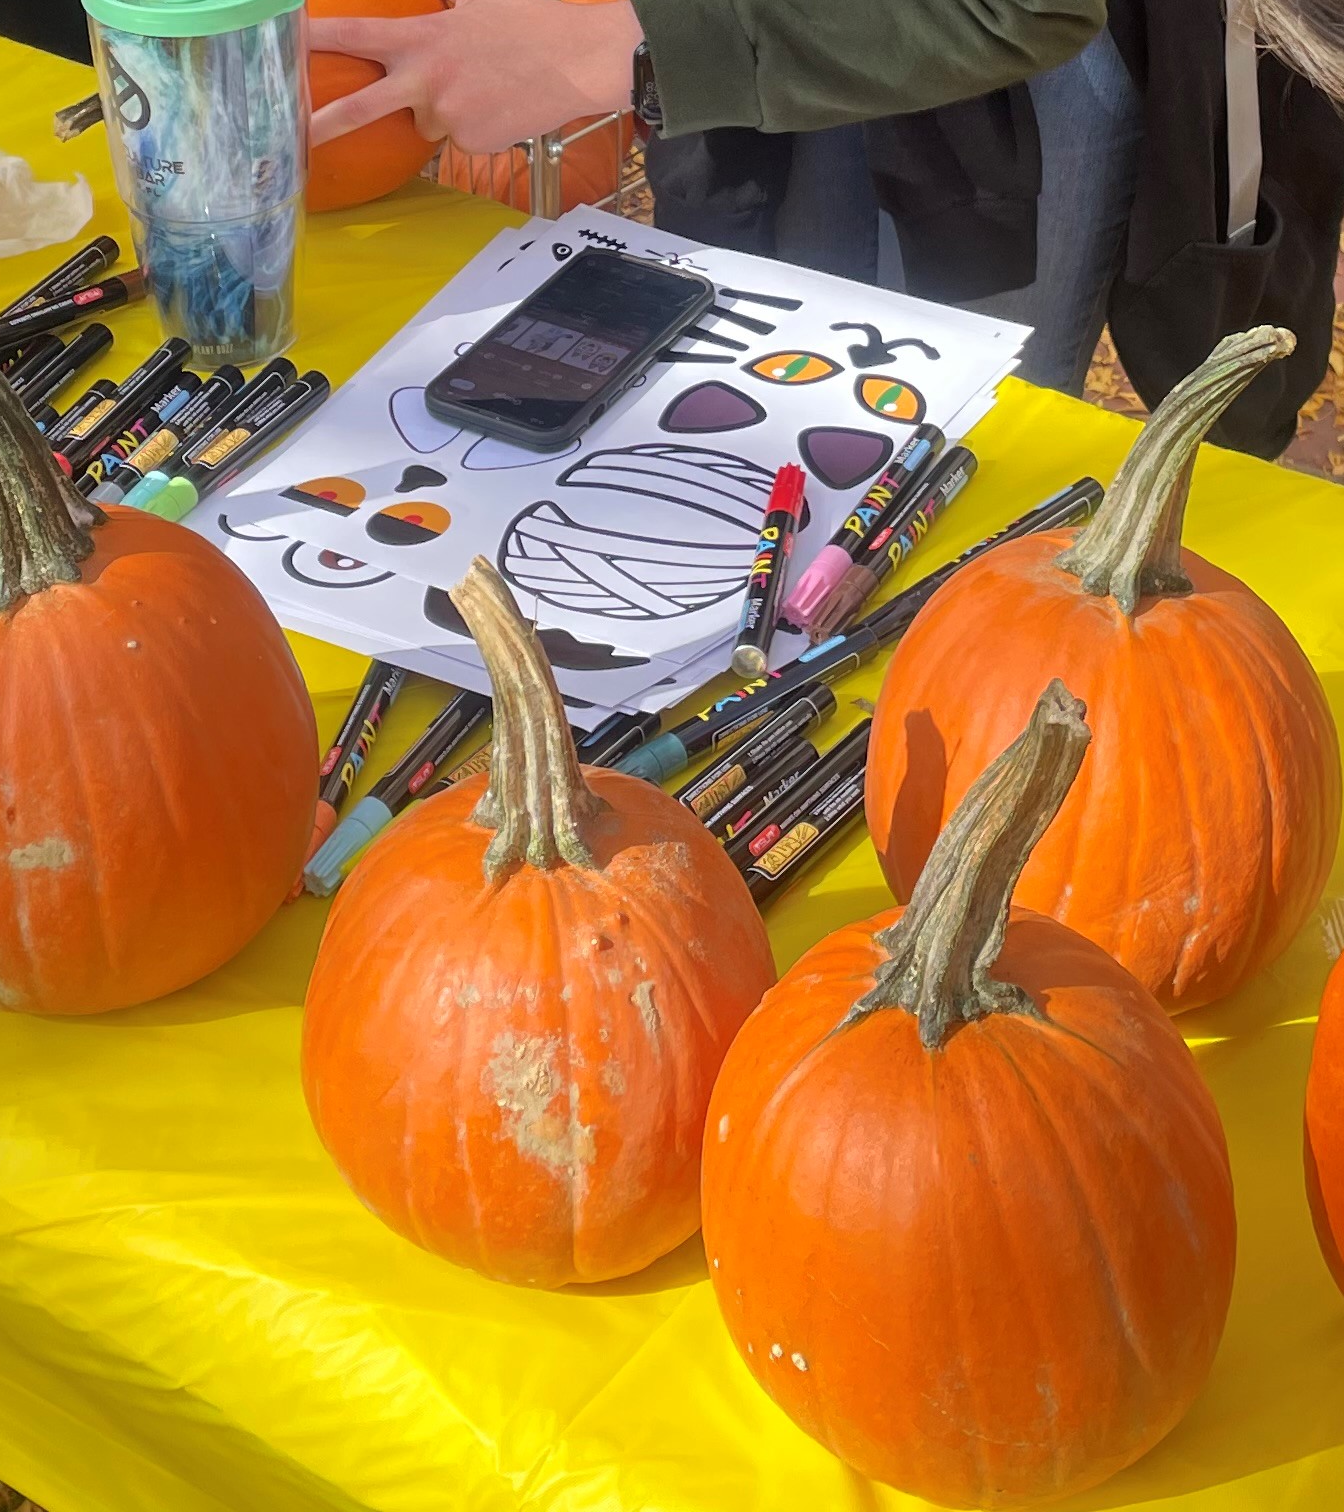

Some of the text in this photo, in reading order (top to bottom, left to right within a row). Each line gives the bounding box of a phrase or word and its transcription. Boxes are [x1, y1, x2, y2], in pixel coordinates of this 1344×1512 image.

[86, 417, 149, 486] PAINT
[150, 384, 182, 414] Marker
[844, 471, 900, 538] PAINT
[894, 437, 920, 465] Marker
[887, 498, 935, 572] PAINT
[939, 465, 965, 497] Marker
[745, 526, 779, 630] PAINT Marker
[341, 703, 382, 796] PAINT
